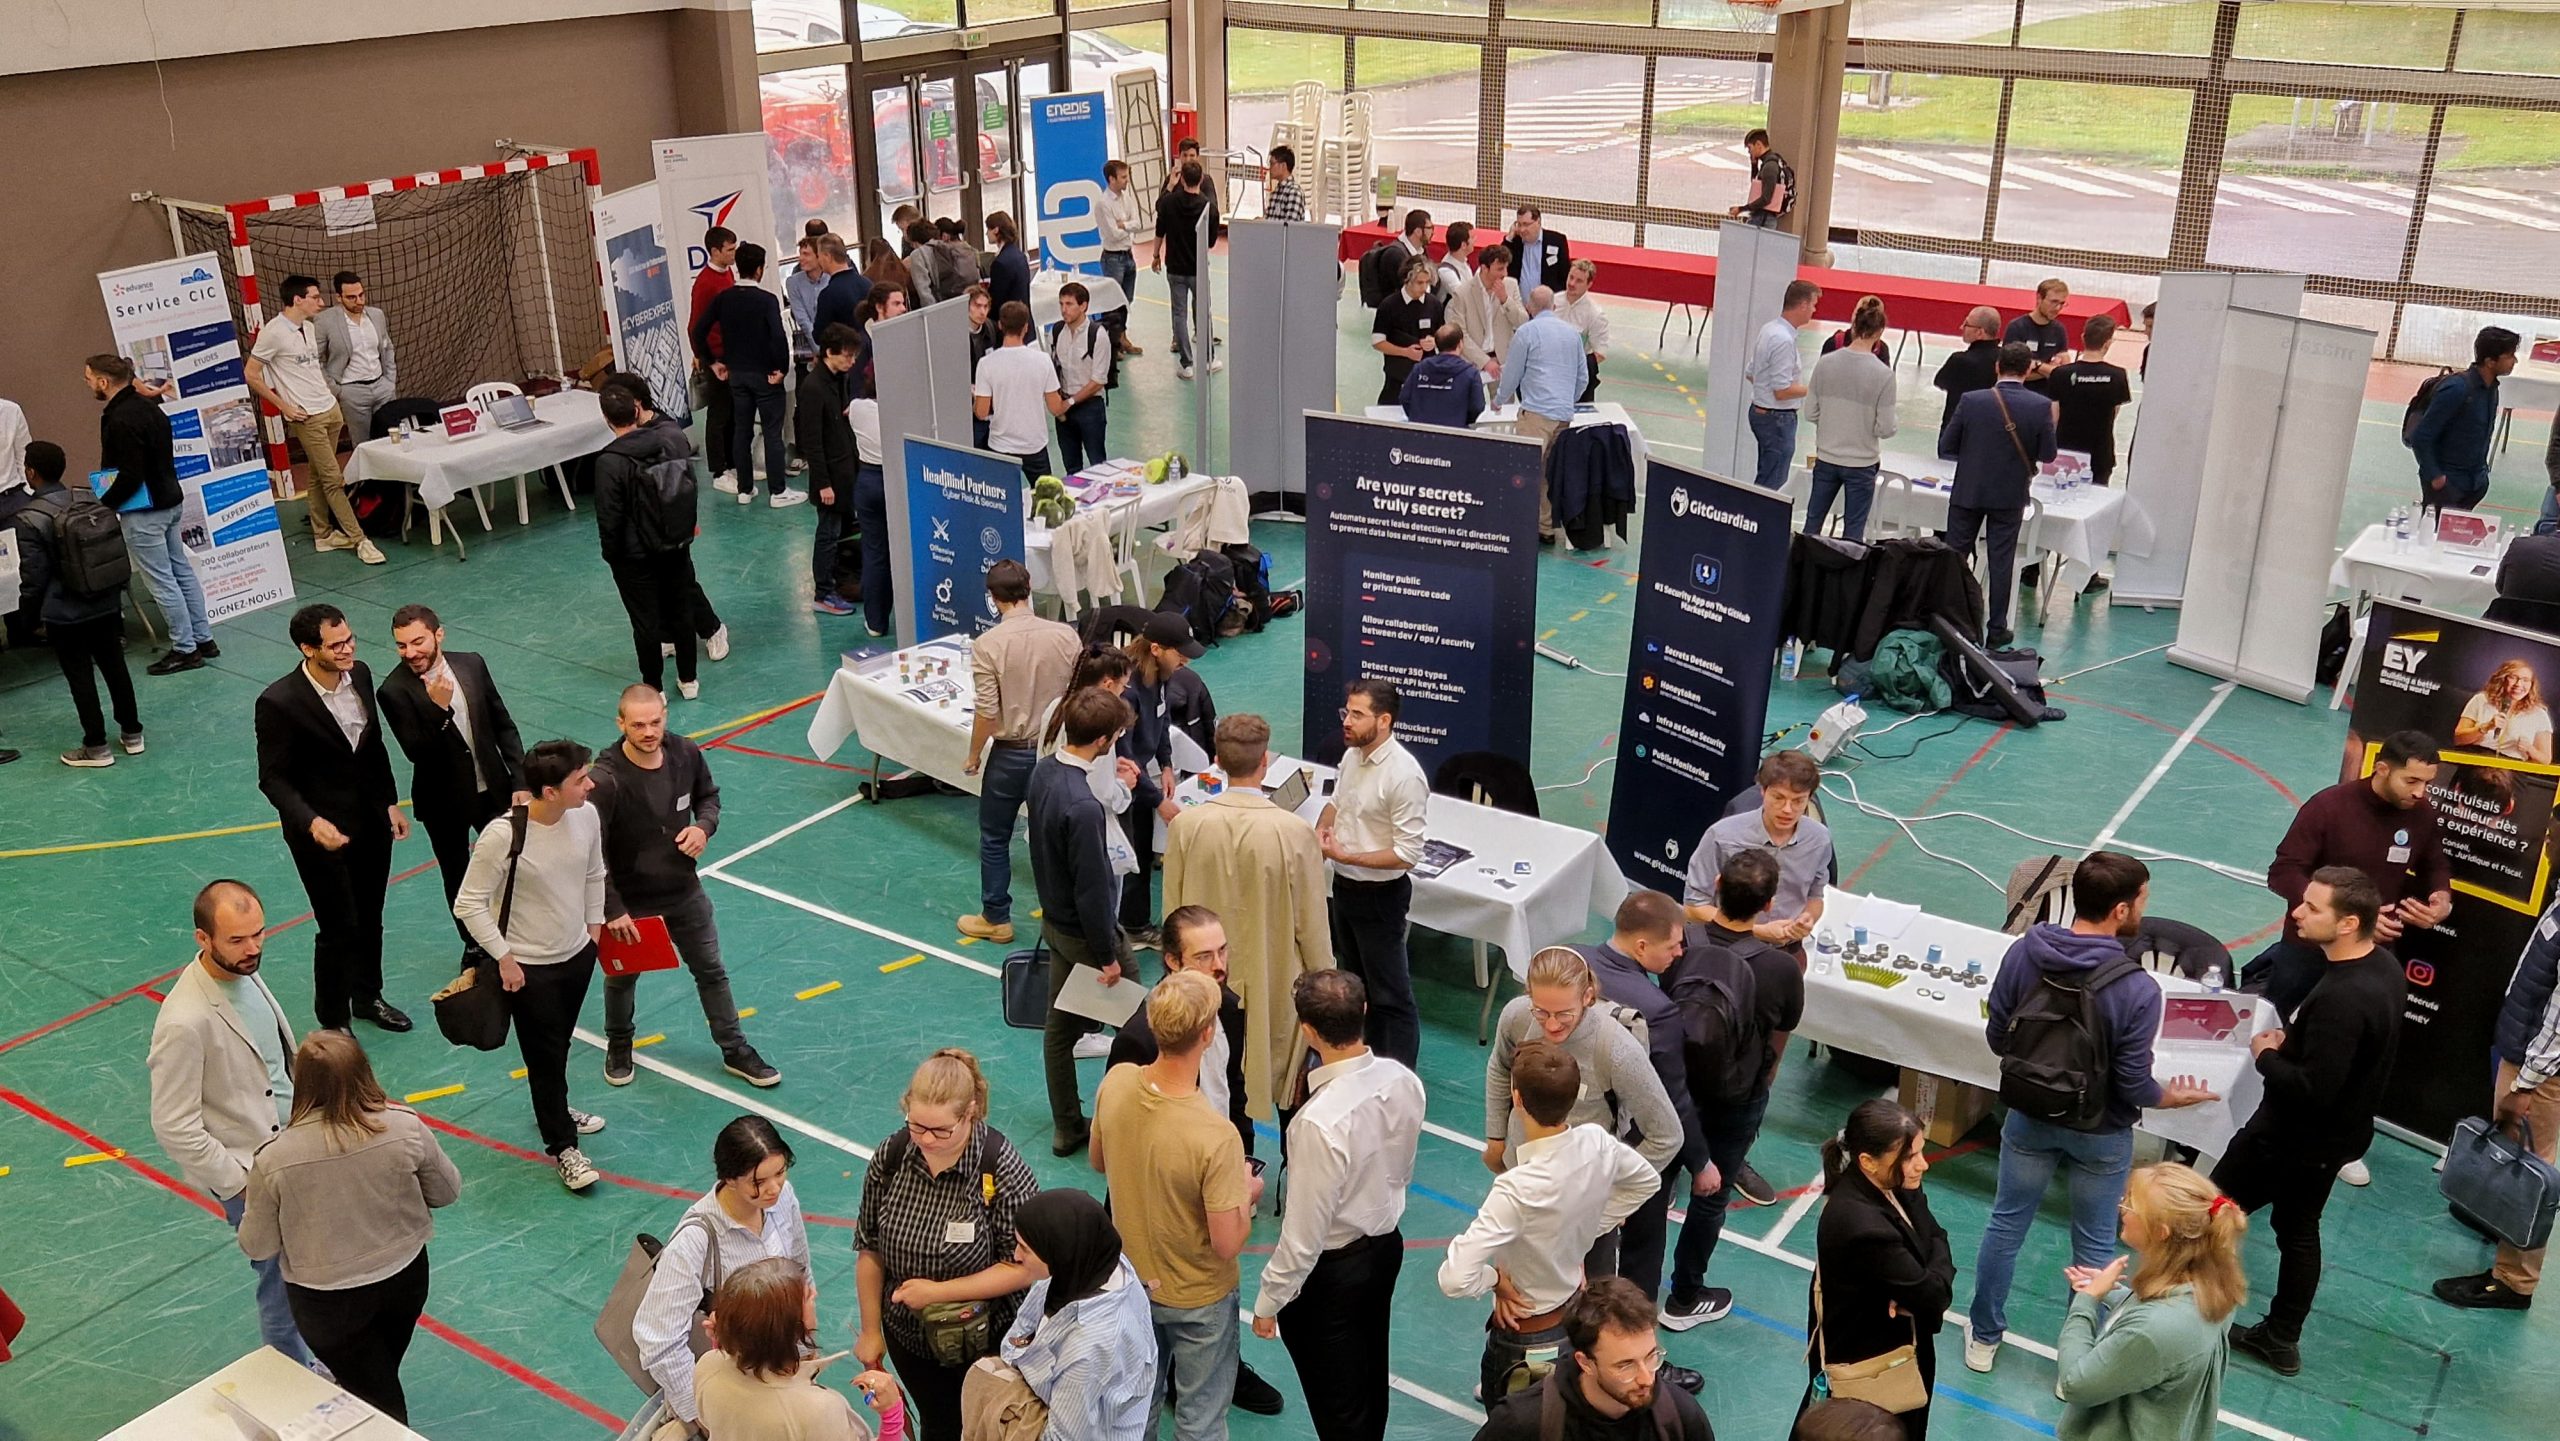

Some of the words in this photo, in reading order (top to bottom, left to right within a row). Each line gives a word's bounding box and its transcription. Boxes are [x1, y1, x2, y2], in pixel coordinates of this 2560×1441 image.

[116, 296, 180, 318] Service
[189, 286, 216, 302] CIC
[174, 443, 193, 452] UITS
[1403, 453, 1451, 468] GitGuardian
[922, 464, 965, 491] HeadMind
[966, 476, 1007, 500] Partners
[1356, 476, 1381, 492] Are
[1382, 481, 1416, 496] your
[1418, 486, 1484, 506] secrets...
[221, 499, 261, 522] EXPERTISE
[942, 488, 961, 500] Cyber
[961, 492, 975, 504] Risk
[974, 495, 980, 505] &
[980, 497, 1007, 514] Security
[1372, 495, 1408, 516] truly
[1410, 501, 1466, 521] secret?
[1330, 511, 1367, 524] Automate
[1367, 516, 1391, 527] secret
[1390, 519, 1411, 530] leaks
[1410, 521, 1447, 535] detection
[1447, 526, 1456, 535] in
[1456, 527, 1468, 537] Git
[1468, 529, 1511, 543] directories
[1689, 499, 1759, 534] GitGuardian
[929, 543, 955, 557] Offensive
[1330, 522, 1339, 531] to
[1339, 525, 1368, 536] prevent
[1368, 526, 1386, 538] data
[1386, 530, 1401, 540] loss
[1401, 532, 1416, 542] and
[1417, 535, 1442, 546] secure
[1442, 538, 1461, 548] your
[1461, 540, 1510, 554] applications.
[218, 541, 270, 562] collaborateurs
[932, 552, 954, 566] Security
[1362, 569, 1395, 583] Monitor
[1395, 574, 1421, 586] public
[1702, 565, 1710, 578] 1
[1362, 582, 1371, 590] or
[1372, 583, 1402, 595] private
[1402, 588, 1430, 598] source
[1430, 590, 1451, 601] code
[207, 589, 277, 619] OIGNEZ-NOUS
[934, 604, 956, 617] Security
[1664, 585, 1692, 603] Security
[1691, 594, 1706, 608] App
[1705, 600, 1715, 610] on
[1715, 602, 1728, 614] The
[1727, 607, 1751, 624] GitHub
[1681, 601, 1723, 623] Marketplace
[932, 611, 940, 621] by
[940, 614, 959, 626] Design
[1362, 615, 1385, 626] Allow
[1385, 617, 1439, 633] collaboration
[1362, 625, 1397, 639] between
[1397, 630, 1414, 641] dev
[1419, 635, 1435, 645] ops
[1440, 637, 1475, 651] security
[1664, 645, 1689, 662] Secrets
[1690, 654, 1724, 675] Detection
[2383, 642, 2428, 674] EY
[1361, 660, 1388, 672] Detect
[1389, 666, 1407, 675] over
[1407, 667, 1424, 677] 350
[1424, 670, 1448, 681] types
[2380, 668, 2410, 685] Building
[2411, 678, 2417, 686] a
[2417, 678, 2441, 691] better
[1361, 671, 1370, 680] of
[1403, 676, 1417, 687] API
[1417, 680, 1439, 691] keys,
[1439, 683, 1466, 695] token,
[1660, 680, 1701, 703] Honeytoken
[2379, 676, 2409, 692] working
[2409, 683, 2431, 696] world
[1393, 732, 1439, 745] ntegrations
[1431, 727, 1447, 736] and
[1656, 714, 1673, 729] Infra
[1673, 722, 1681, 732] as
[1681, 726, 1699, 739] Code
[1699, 732, 1726, 752] Security
[1652, 748, 1673, 765] Public
[1673, 757, 1710, 781] Monitoring
[2425, 783, 2501, 814] construisais
[2441, 802, 2494, 826] meilleur
[2495, 819, 2518, 835] dès
[2442, 838, 2471, 852] Conseil,
[2447, 819, 2517, 849] expérience
[2519, 841, 2529, 853] ?
[1634, 850, 1687, 881] www.gitguardia
[2455, 850, 2491, 869] Juridique
[2491, 862, 2500, 871] et
[2500, 865, 2523, 879] Fiscal.
